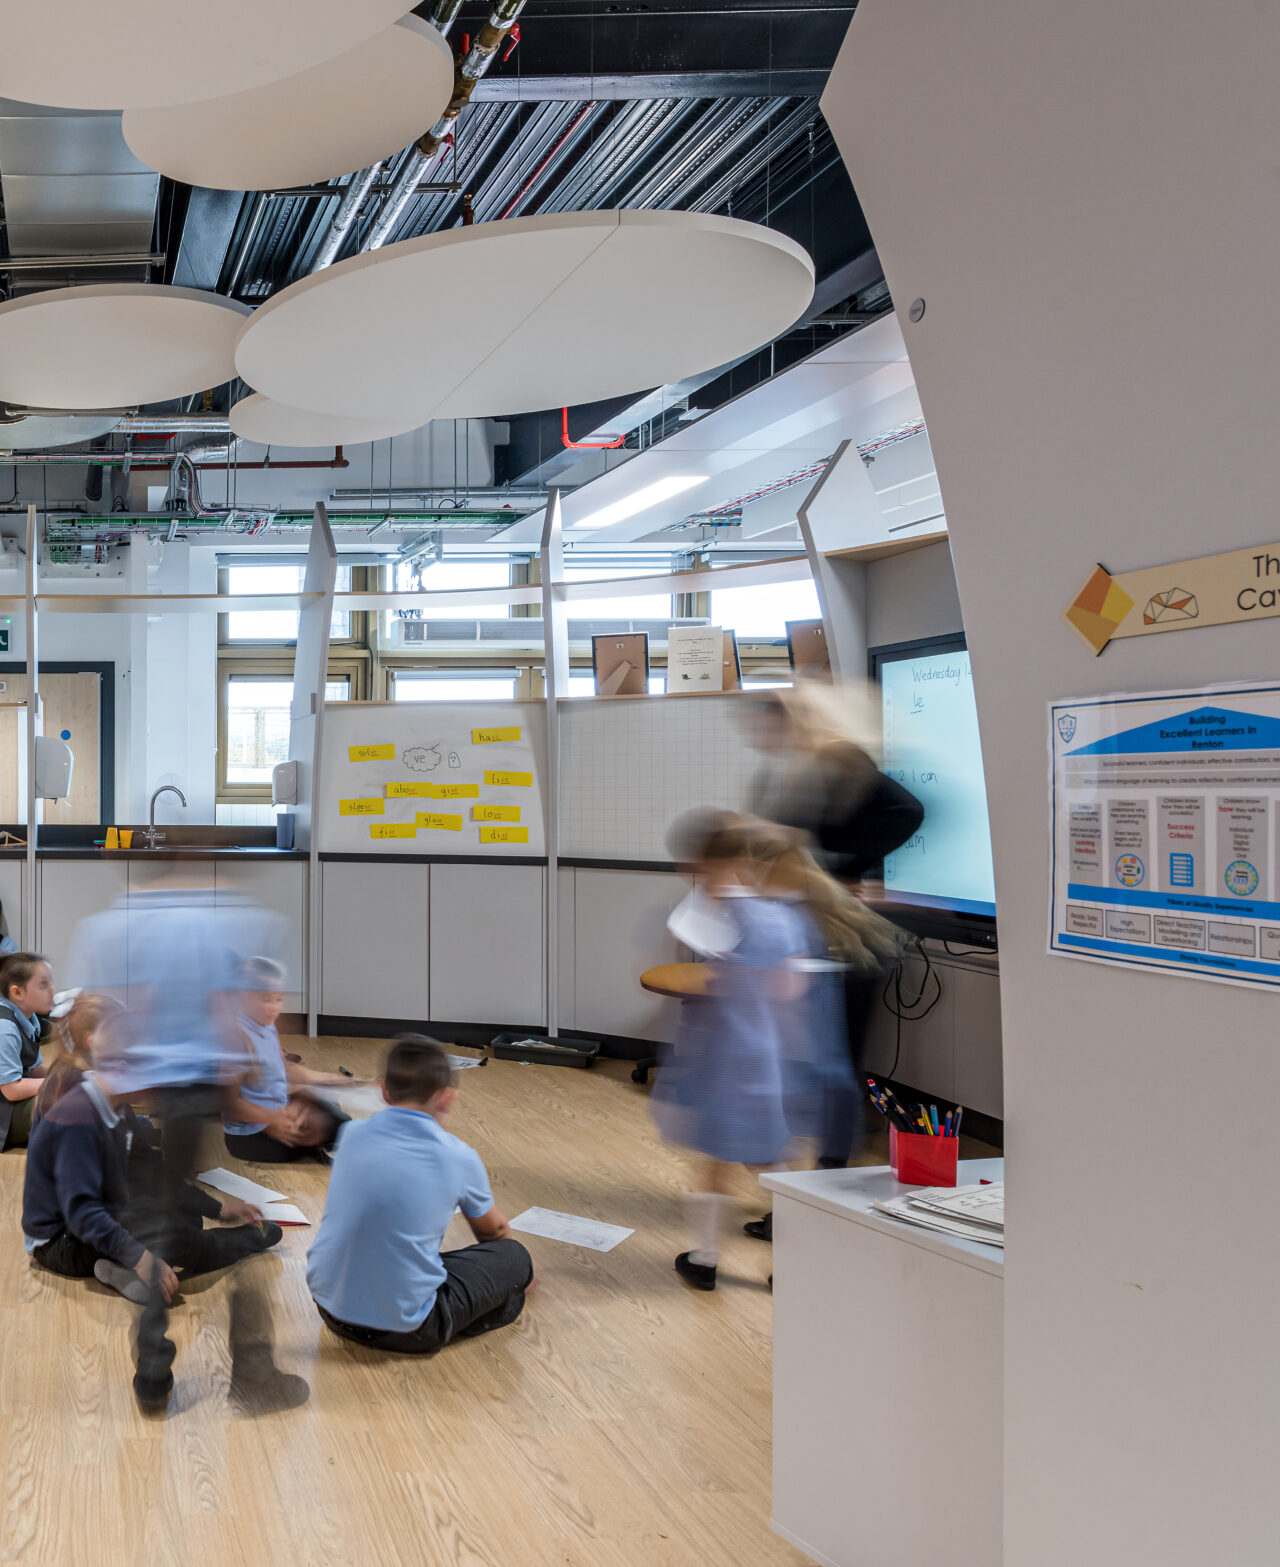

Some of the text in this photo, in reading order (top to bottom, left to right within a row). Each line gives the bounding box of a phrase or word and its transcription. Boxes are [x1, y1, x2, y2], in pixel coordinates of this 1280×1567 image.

[1238, 588, 1280, 611] Ca
[912, 666, 961, 687] Wednesday
[1189, 716, 1226, 726] Building
[479, 732, 500, 742] have
[1160, 726, 1257, 738] Excellent Learners in
[1191, 740, 1224, 749] Renton
[358, 748, 377, 757] solve
[414, 754, 426, 764] ve
[492, 772, 510, 784] live
[394, 784, 417, 794] above
[441, 787, 458, 798] give
[348, 802, 371, 812] sleeve
[484, 808, 502, 818] love
[424, 816, 443, 826] glove
[379, 826, 396, 838] five
[490, 829, 508, 840] dive
[1169, 832, 1194, 840] Criteria
[1176, 921, 1203, 931] Teaching
